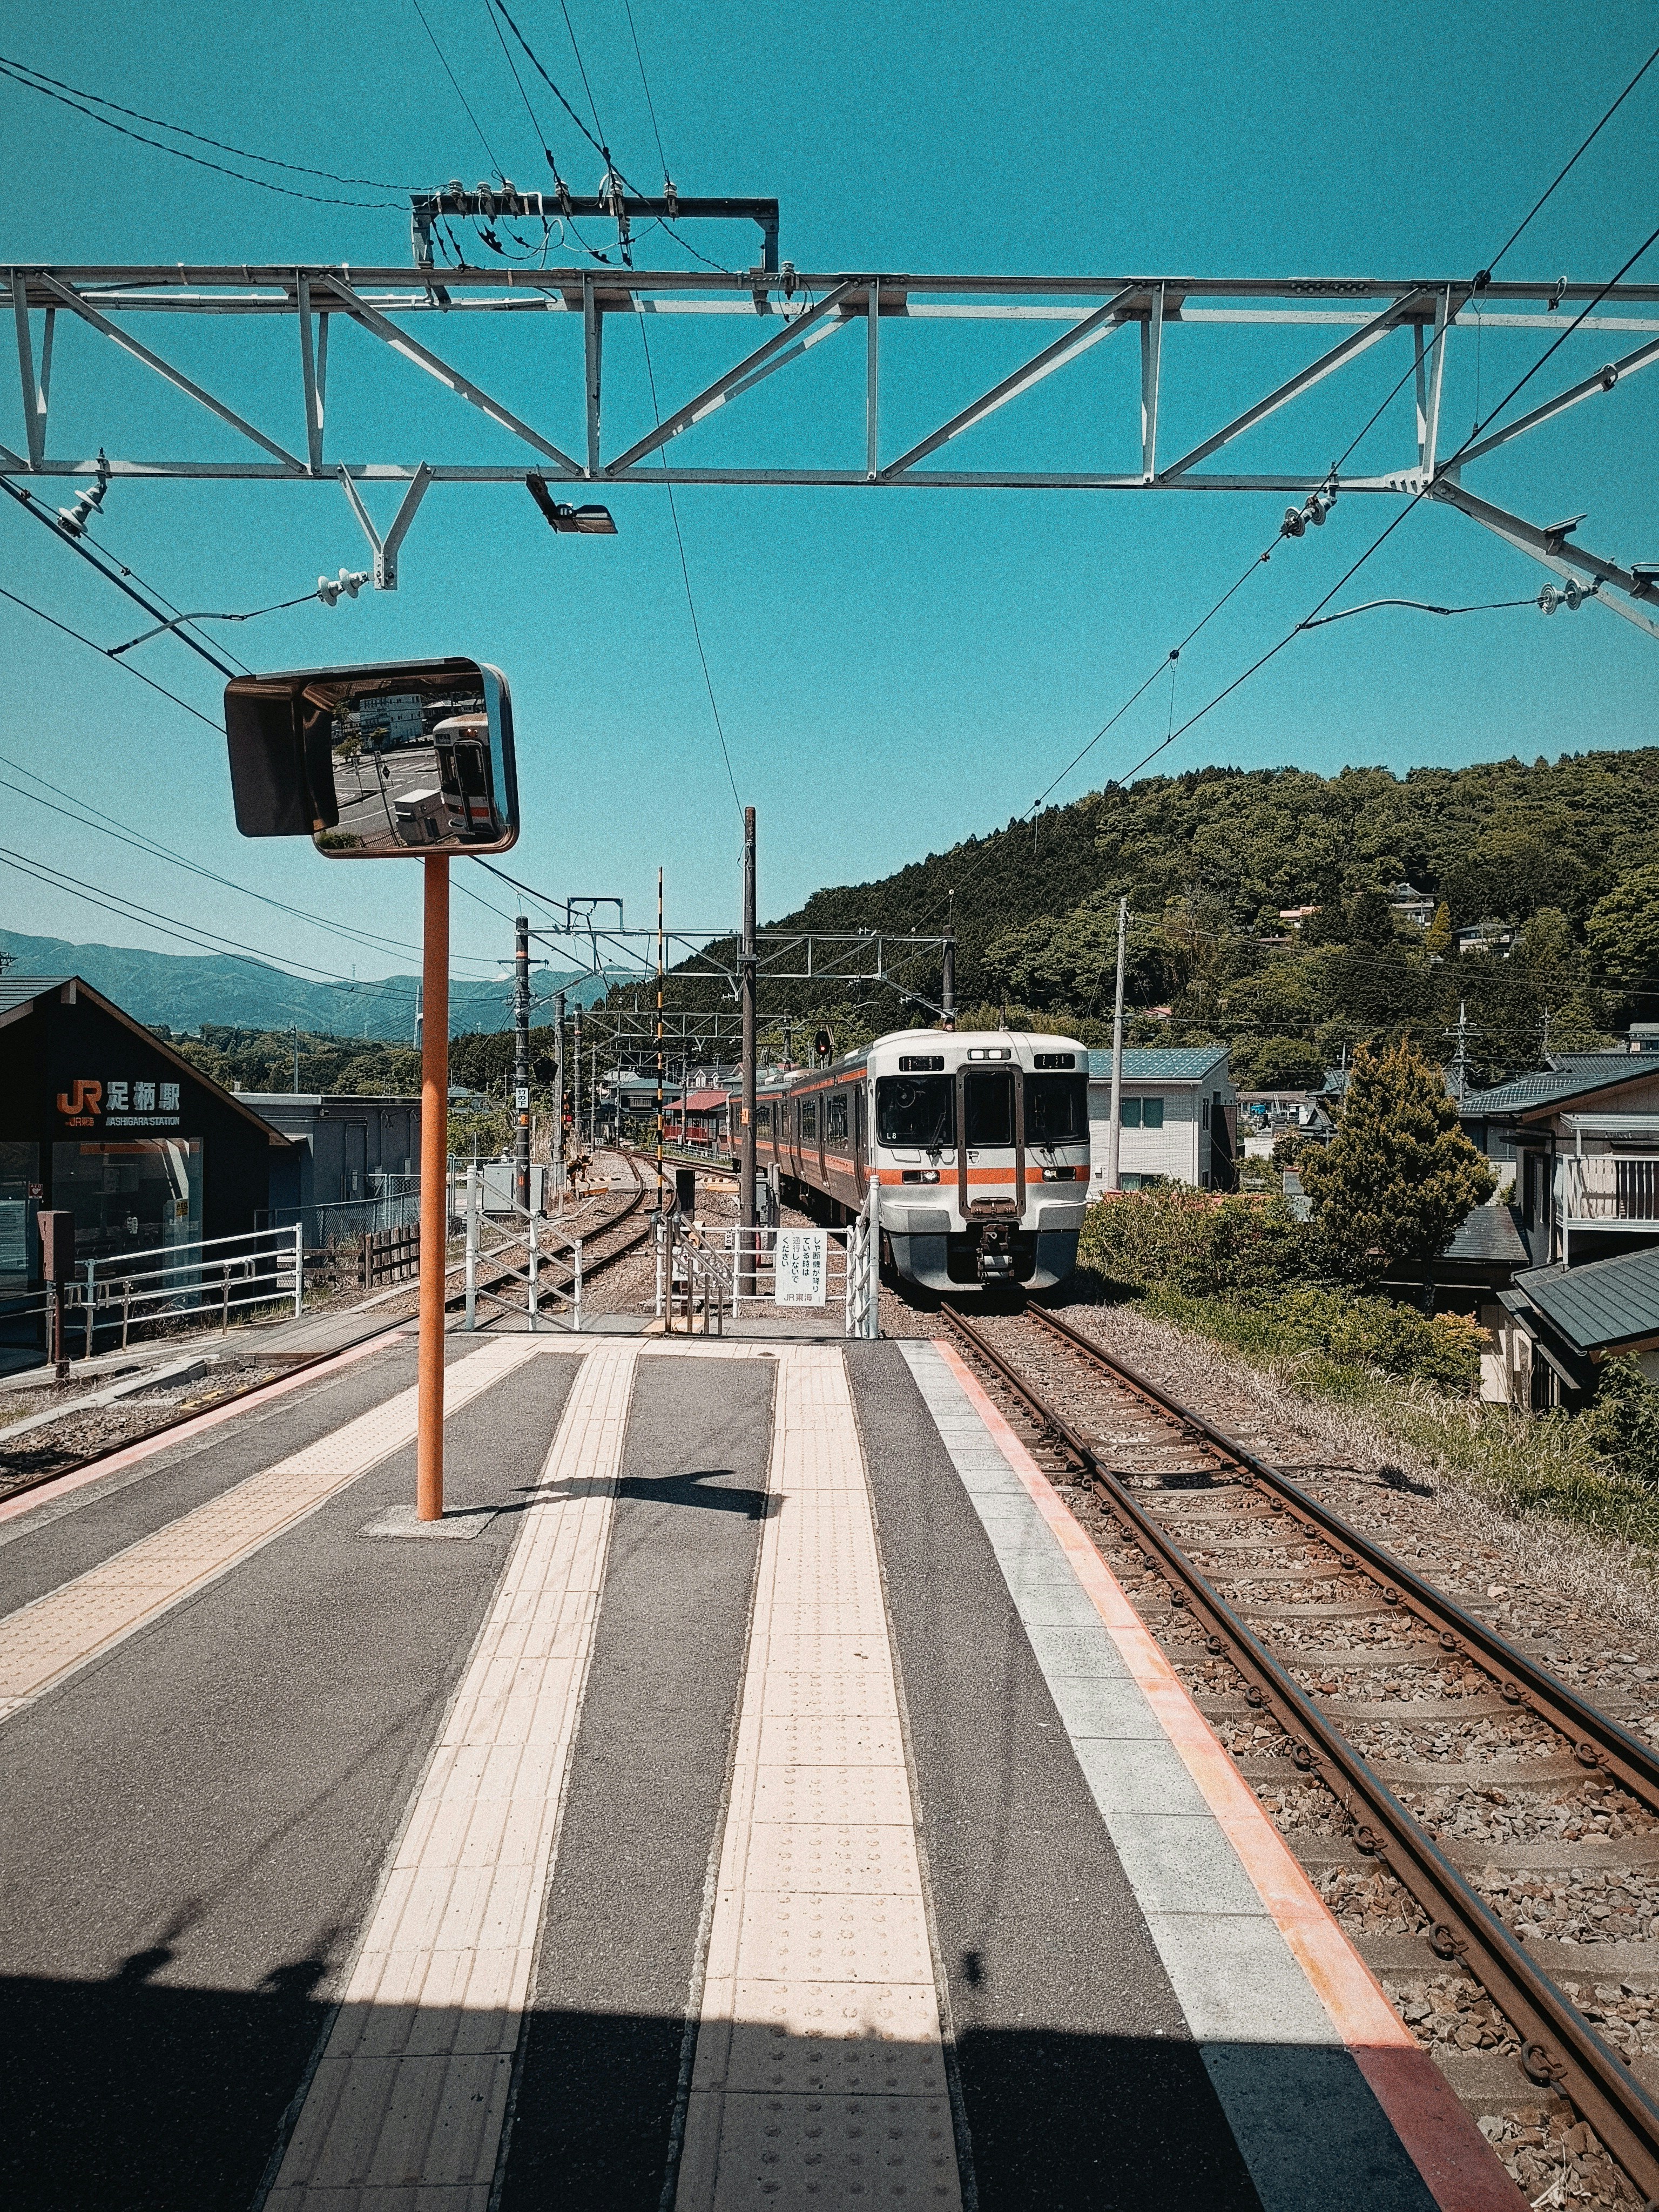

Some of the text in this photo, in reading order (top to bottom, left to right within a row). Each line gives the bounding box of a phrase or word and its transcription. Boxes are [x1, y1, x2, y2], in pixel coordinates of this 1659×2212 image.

[57, 1080, 102, 1114] JR
[106, 1082, 180, 1110] 足柄駅
[518, 1090, 526, 1106] 竹の下
[69, 1117, 94, 1127] JR東海
[106, 1117, 180, 1126] ASHIGARA STATION
[792, 1237, 800, 1283] 通行しないで
[802, 1237, 811, 1276] ている時は
[813, 1237, 821, 1293] しゃ断機が降り
[784, 1293, 812, 1301] JR東海
